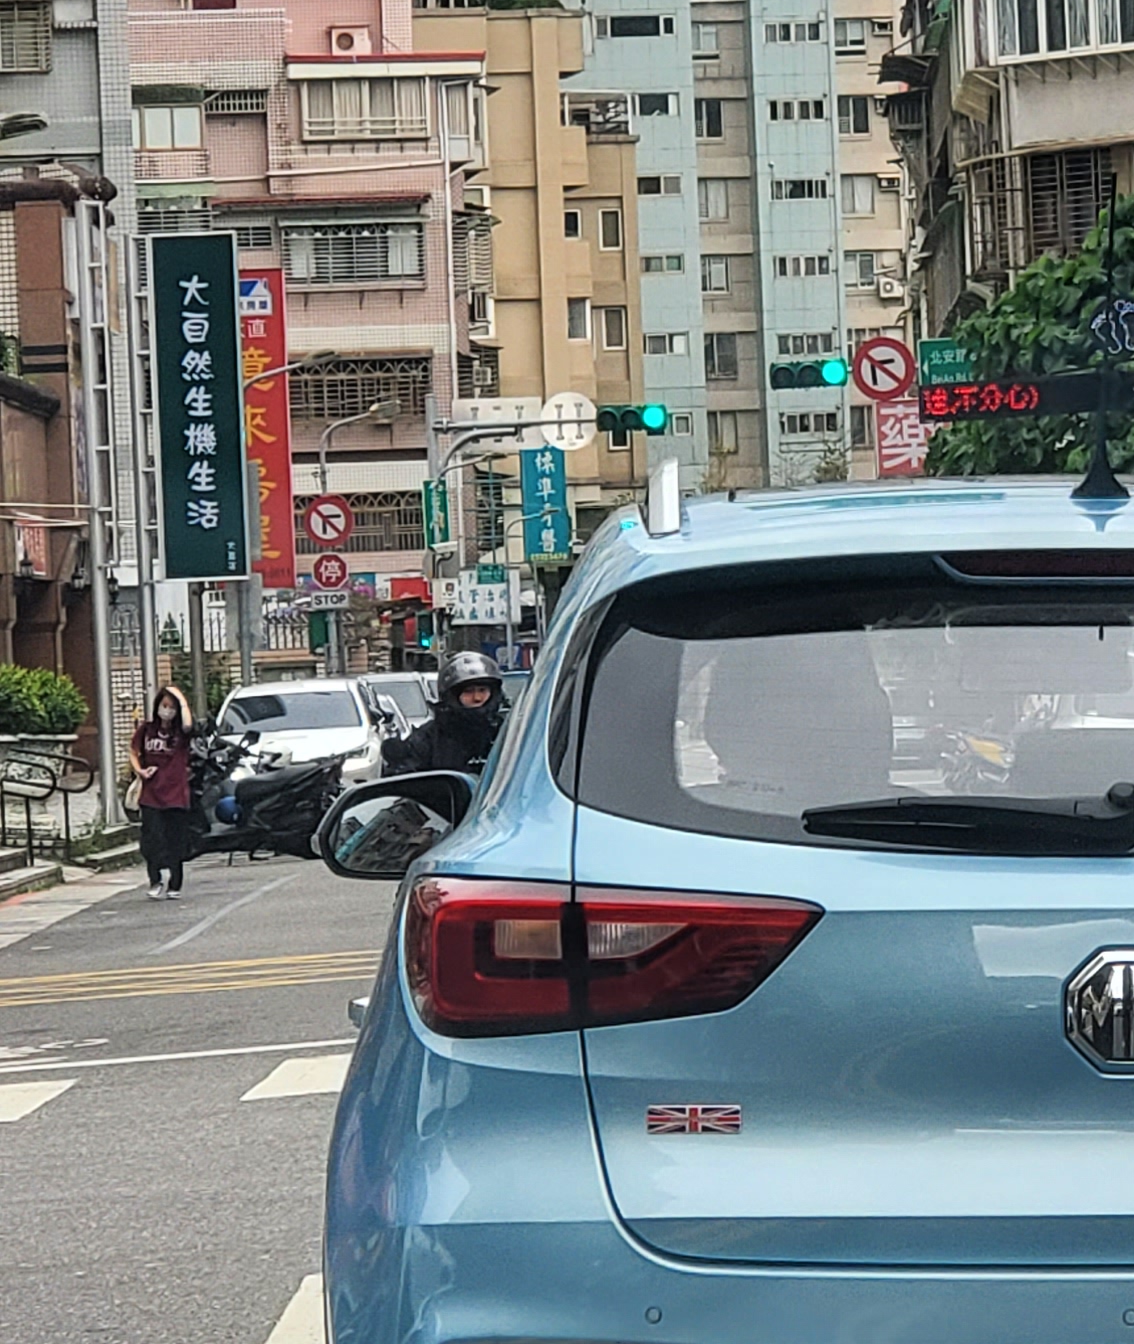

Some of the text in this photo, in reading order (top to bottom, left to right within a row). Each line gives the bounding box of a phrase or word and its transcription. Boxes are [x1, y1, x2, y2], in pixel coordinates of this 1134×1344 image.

[178, 274, 220, 530] 大自然生機生活
[319, 560, 343, 583] 停
[314, 593, 346, 605] STOP
